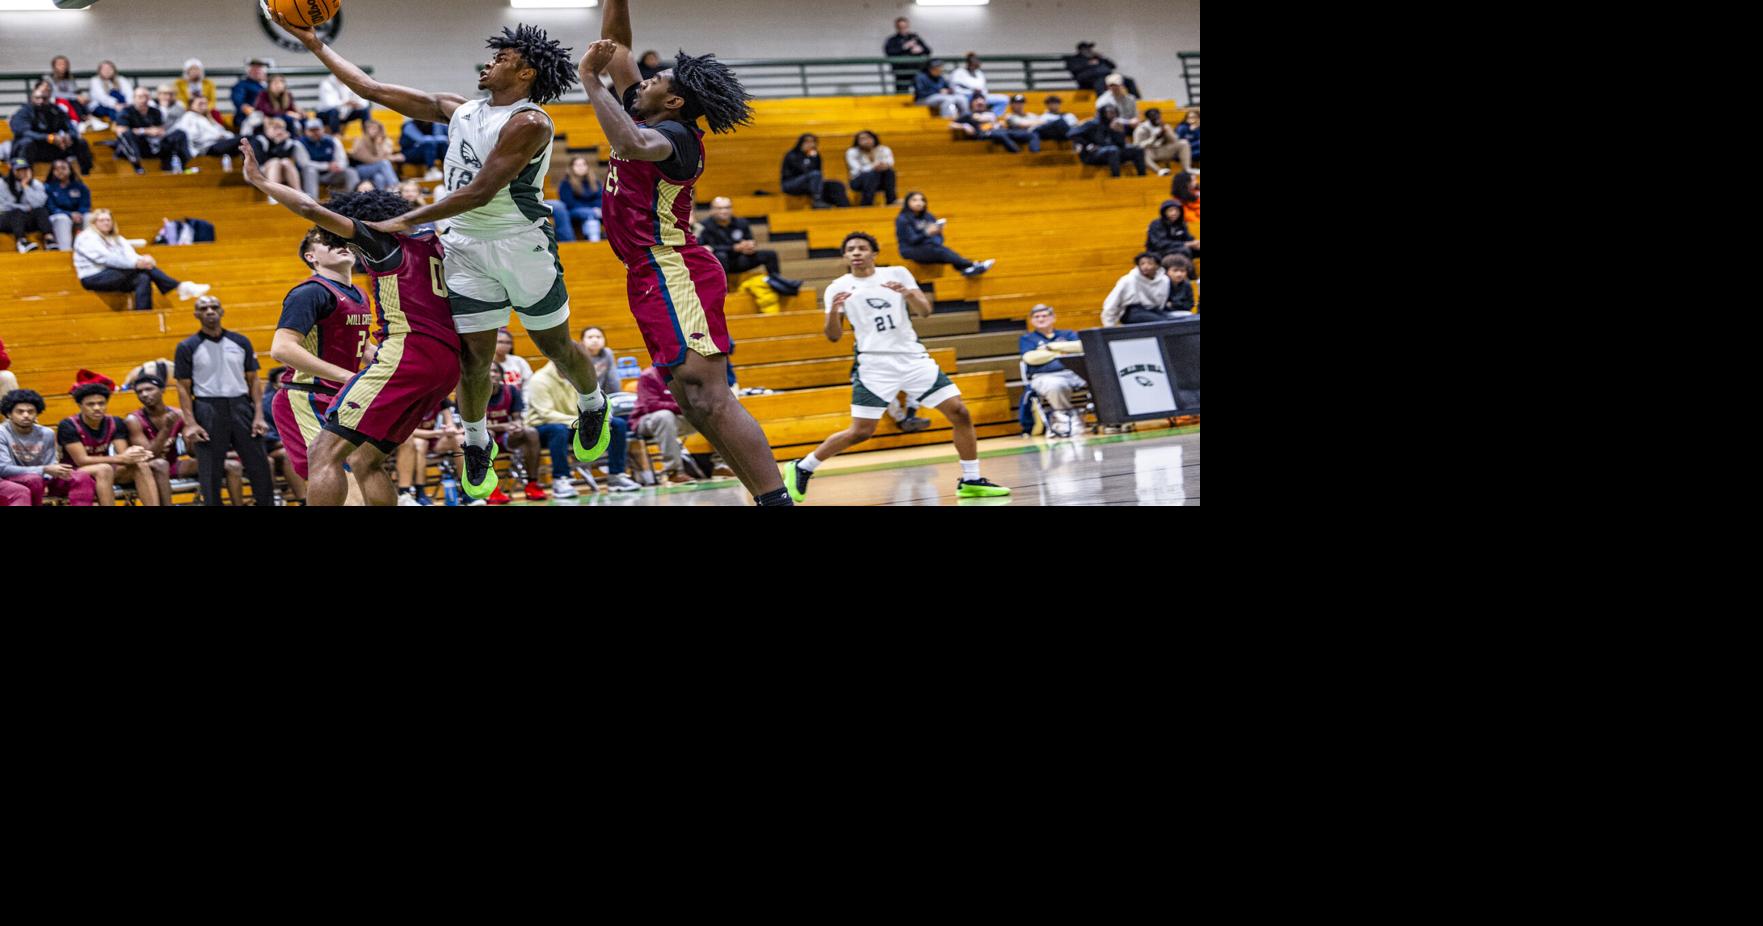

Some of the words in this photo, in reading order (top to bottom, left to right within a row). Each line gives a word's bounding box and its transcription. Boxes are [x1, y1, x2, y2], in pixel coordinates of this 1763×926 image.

[447, 167, 473, 191] 12
[429, 255, 449, 298] 0
[345, 313, 361, 326] MILL
[874, 314, 896, 332] 21
[355, 330, 366, 358] 2
